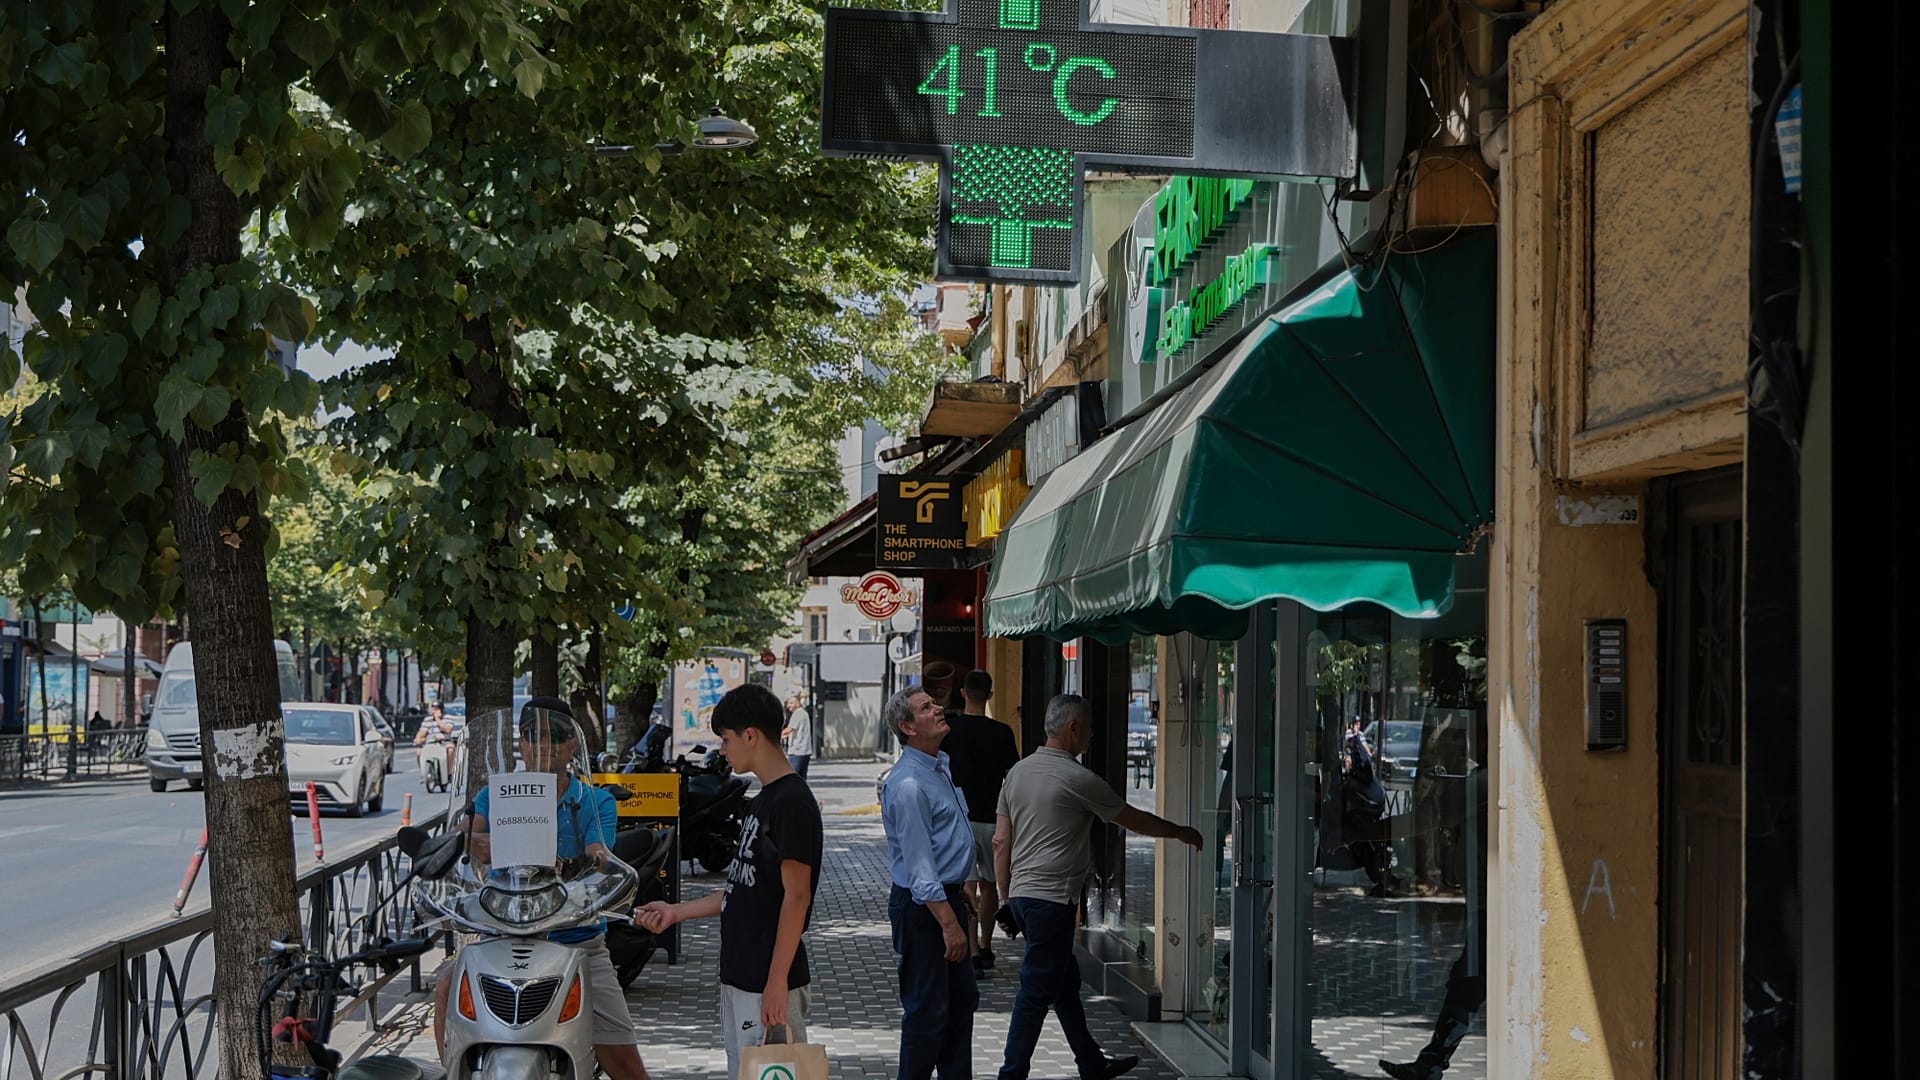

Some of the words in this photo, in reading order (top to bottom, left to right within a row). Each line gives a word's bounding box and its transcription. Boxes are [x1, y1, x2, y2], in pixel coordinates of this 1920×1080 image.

[884, 524, 907, 535] THE
[884, 538, 964, 549] SMARTPHONE
[884, 551, 917, 561] SHOP
[499, 784, 547, 796] SHITET
[621, 783, 637, 791] THE
[496, 816, 550, 827] 0688856566
